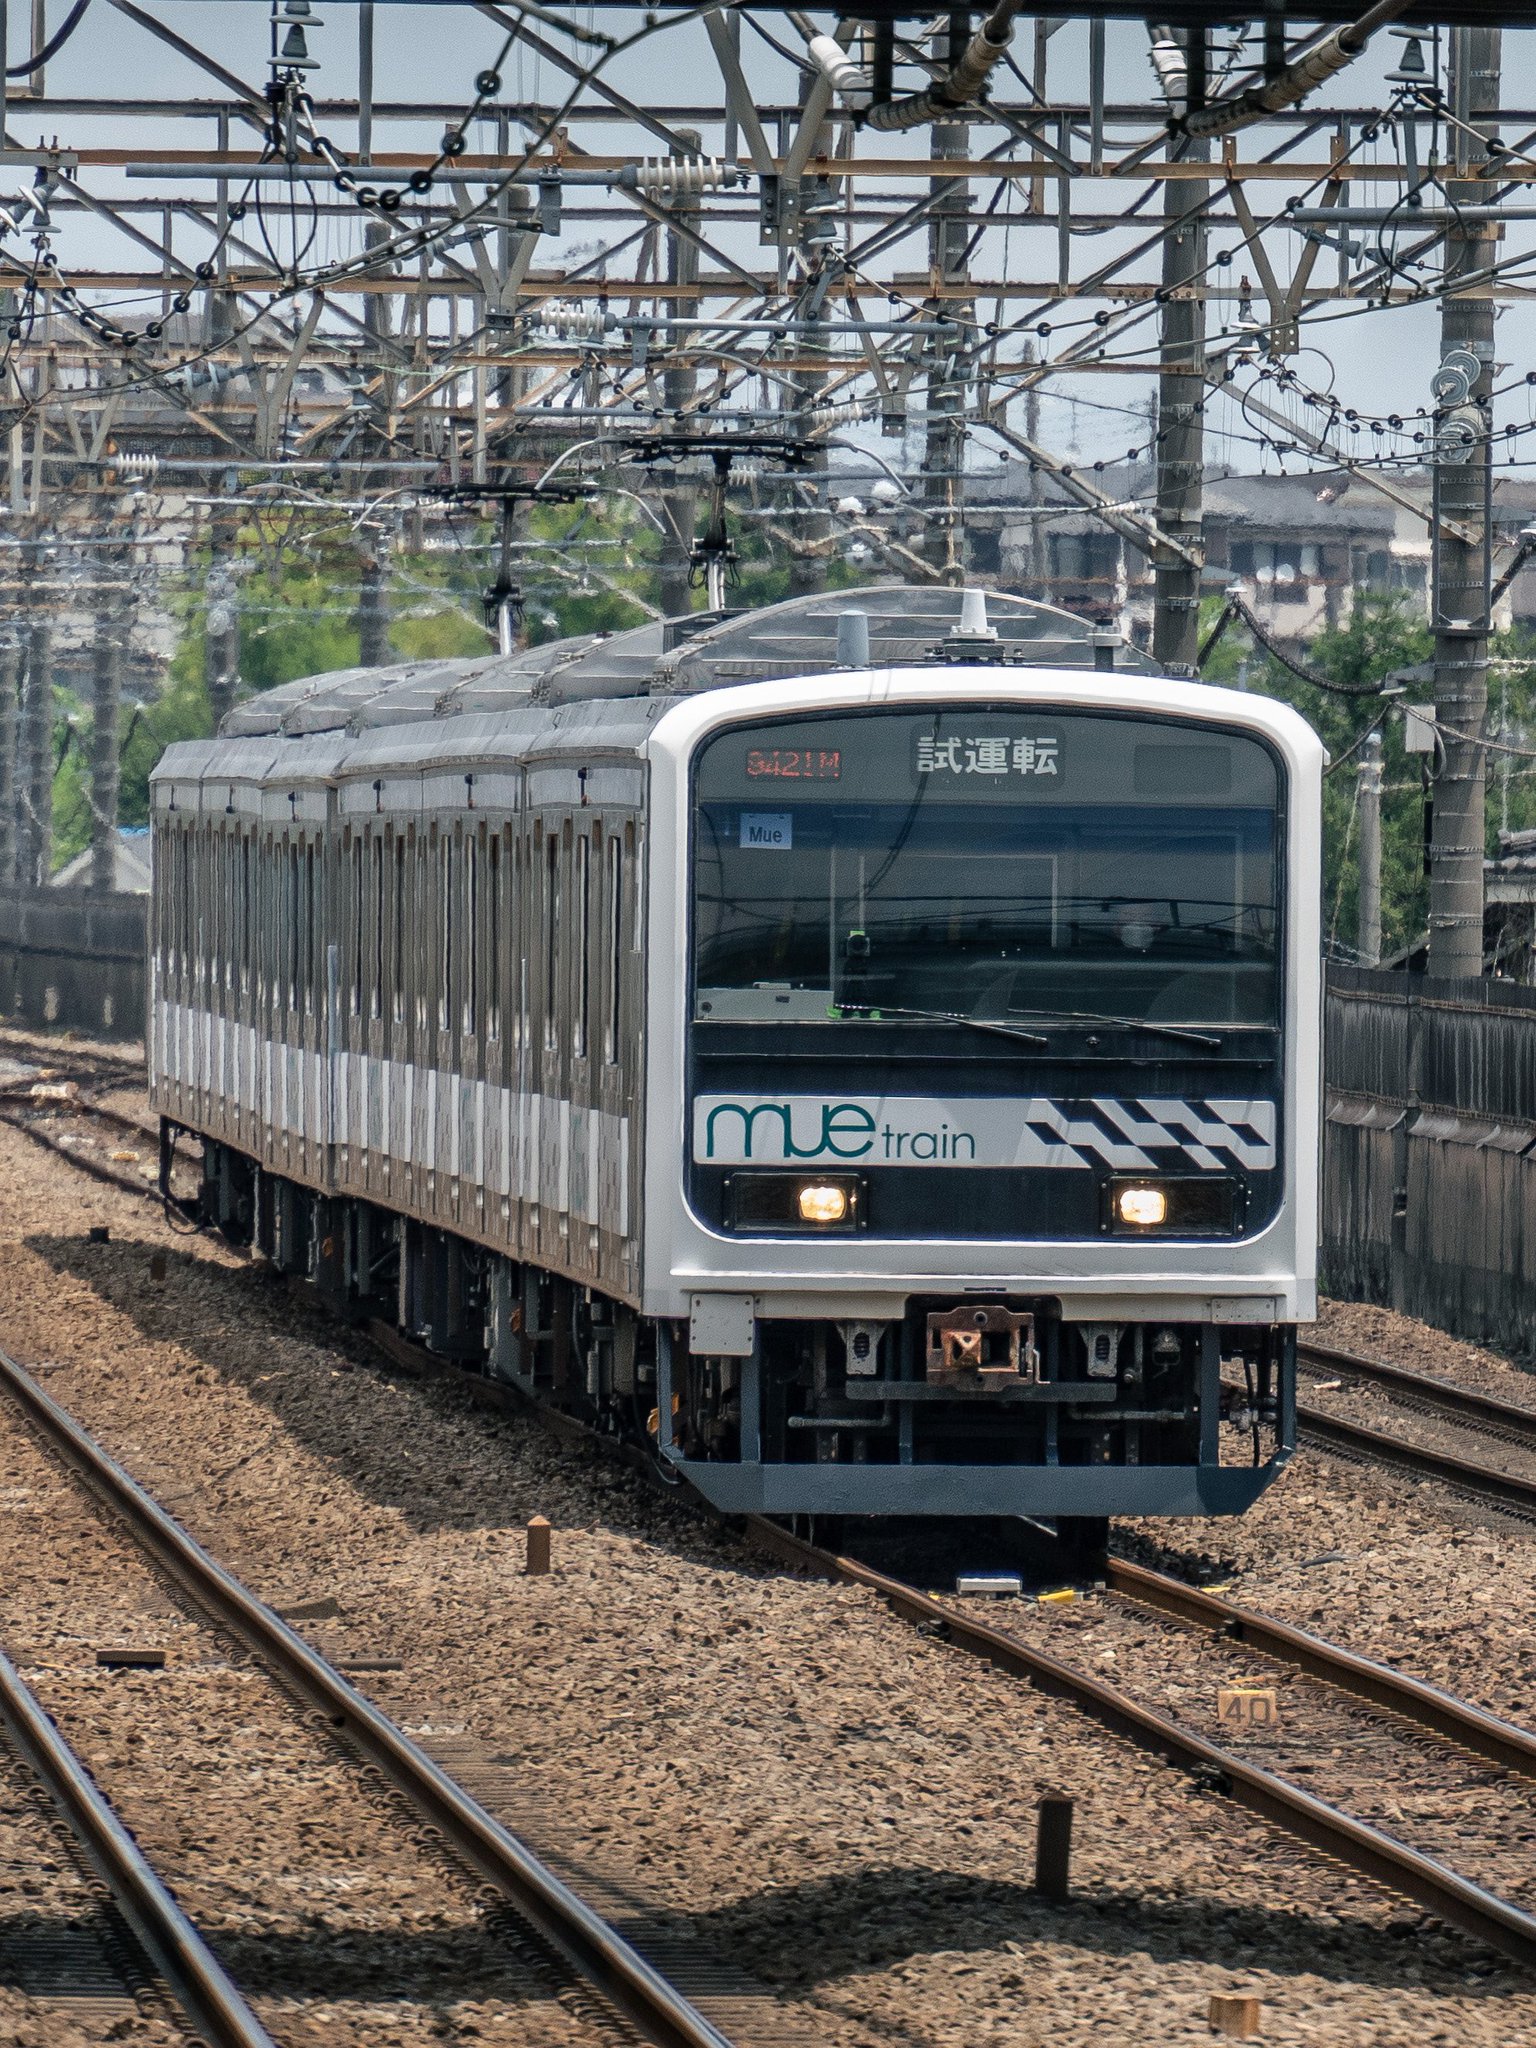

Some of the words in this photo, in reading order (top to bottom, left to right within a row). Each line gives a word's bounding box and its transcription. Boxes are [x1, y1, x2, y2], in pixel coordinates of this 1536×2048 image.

[917, 736, 1059, 776] 試運転
[750, 826, 783, 843] Mue
[706, 1103, 876, 1158] mue
[881, 1124, 976, 1159] train
[1225, 1696, 1271, 1726] 40
